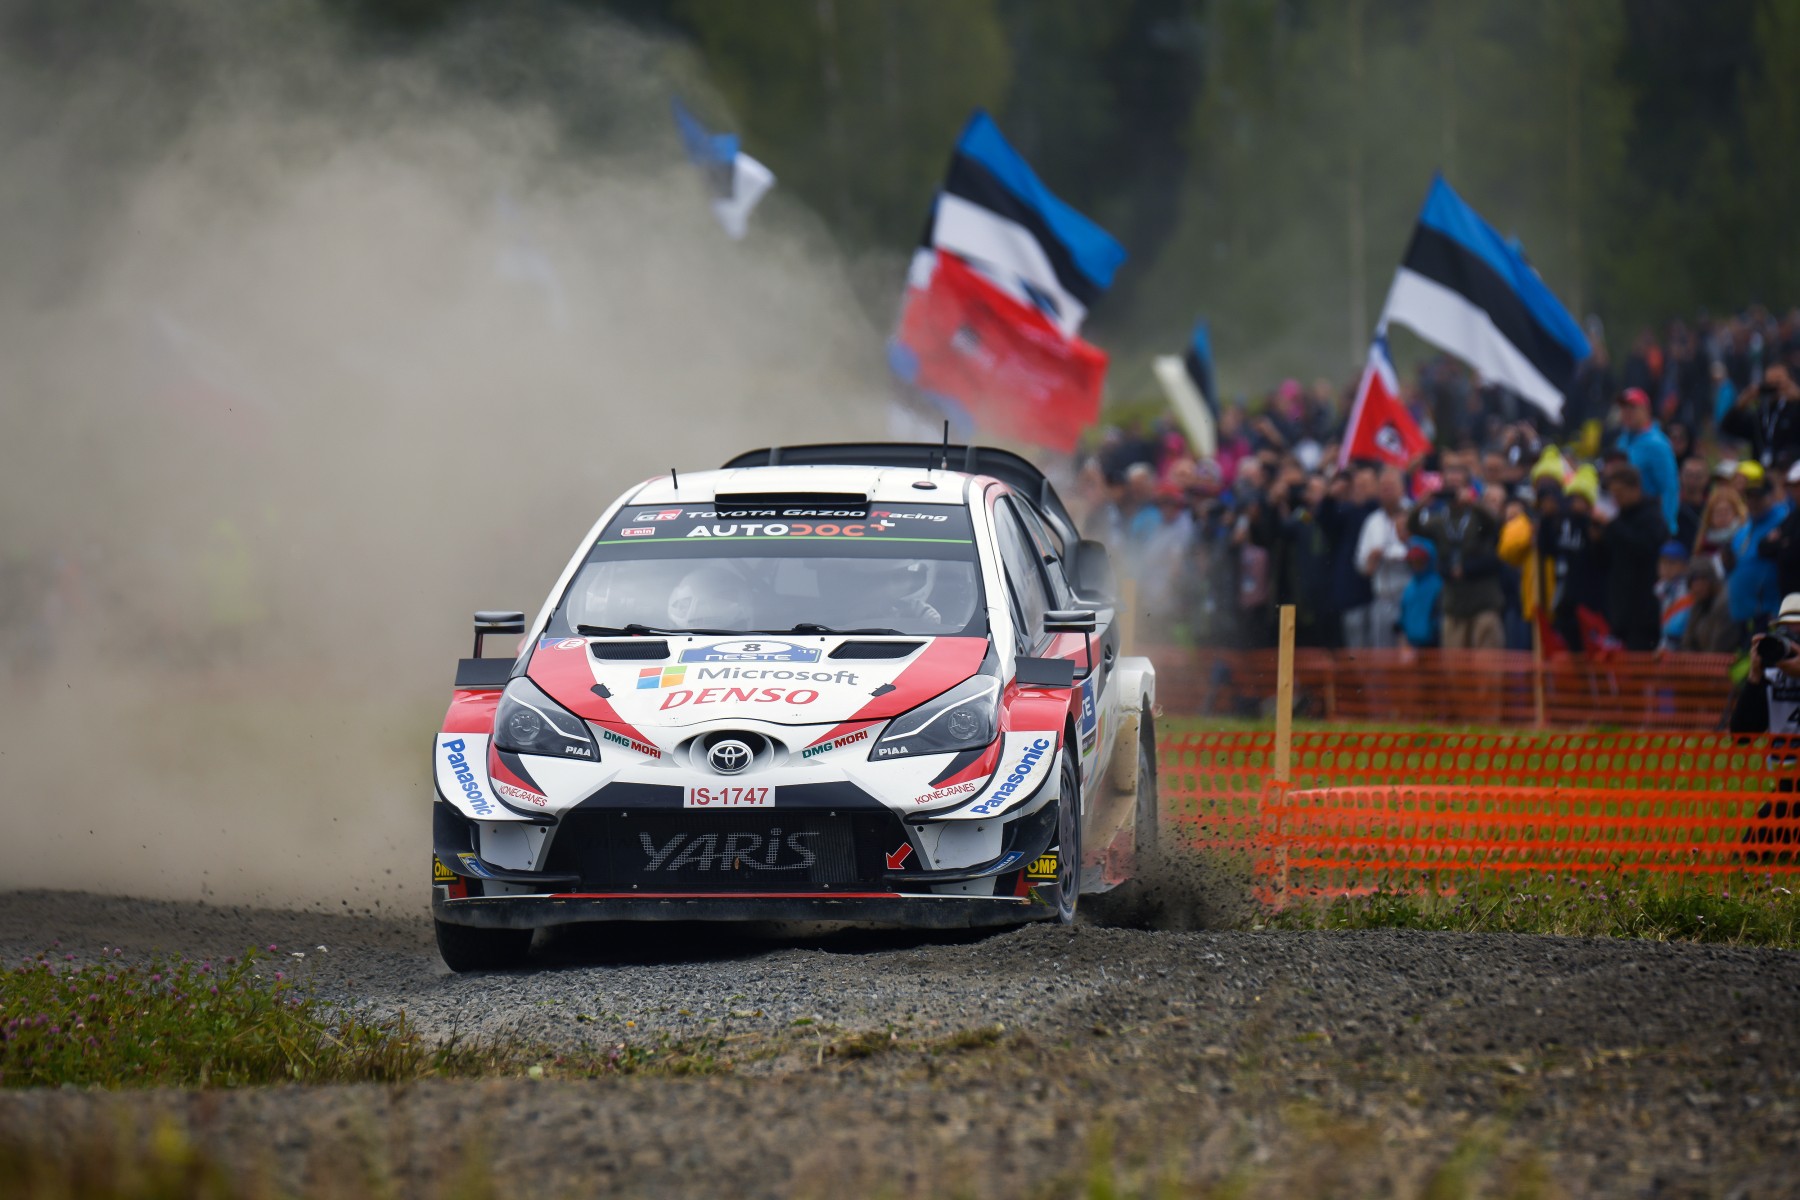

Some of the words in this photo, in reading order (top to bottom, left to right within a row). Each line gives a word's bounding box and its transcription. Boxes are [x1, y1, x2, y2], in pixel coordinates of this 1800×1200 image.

[635, 512, 675, 521] GR
[686, 510, 776, 519] TOYOTA
[782, 509, 866, 517] GAZOO
[871, 510, 948, 522] Racing
[686, 523, 866, 538] AUTODOC
[742, 643, 761, 653] 8
[697, 667, 859, 686] Microsoft
[658, 687, 820, 711] DENSO
[565, 745, 591, 757] PIAA
[603, 730, 630, 748] DMG
[630, 741, 662, 760] MORI
[802, 742, 833, 759] DMG
[834, 730, 869, 748] MORI
[878, 745, 909, 756] PIAA
[442, 738, 496, 817] Panasonic
[969, 738, 1050, 815] Panasonic
[499, 785, 548, 807] KONECRANES
[690, 787, 769, 806] IS-1747
[914, 782, 976, 805] KONECRANES
[1027, 859, 1057, 874] OMP
